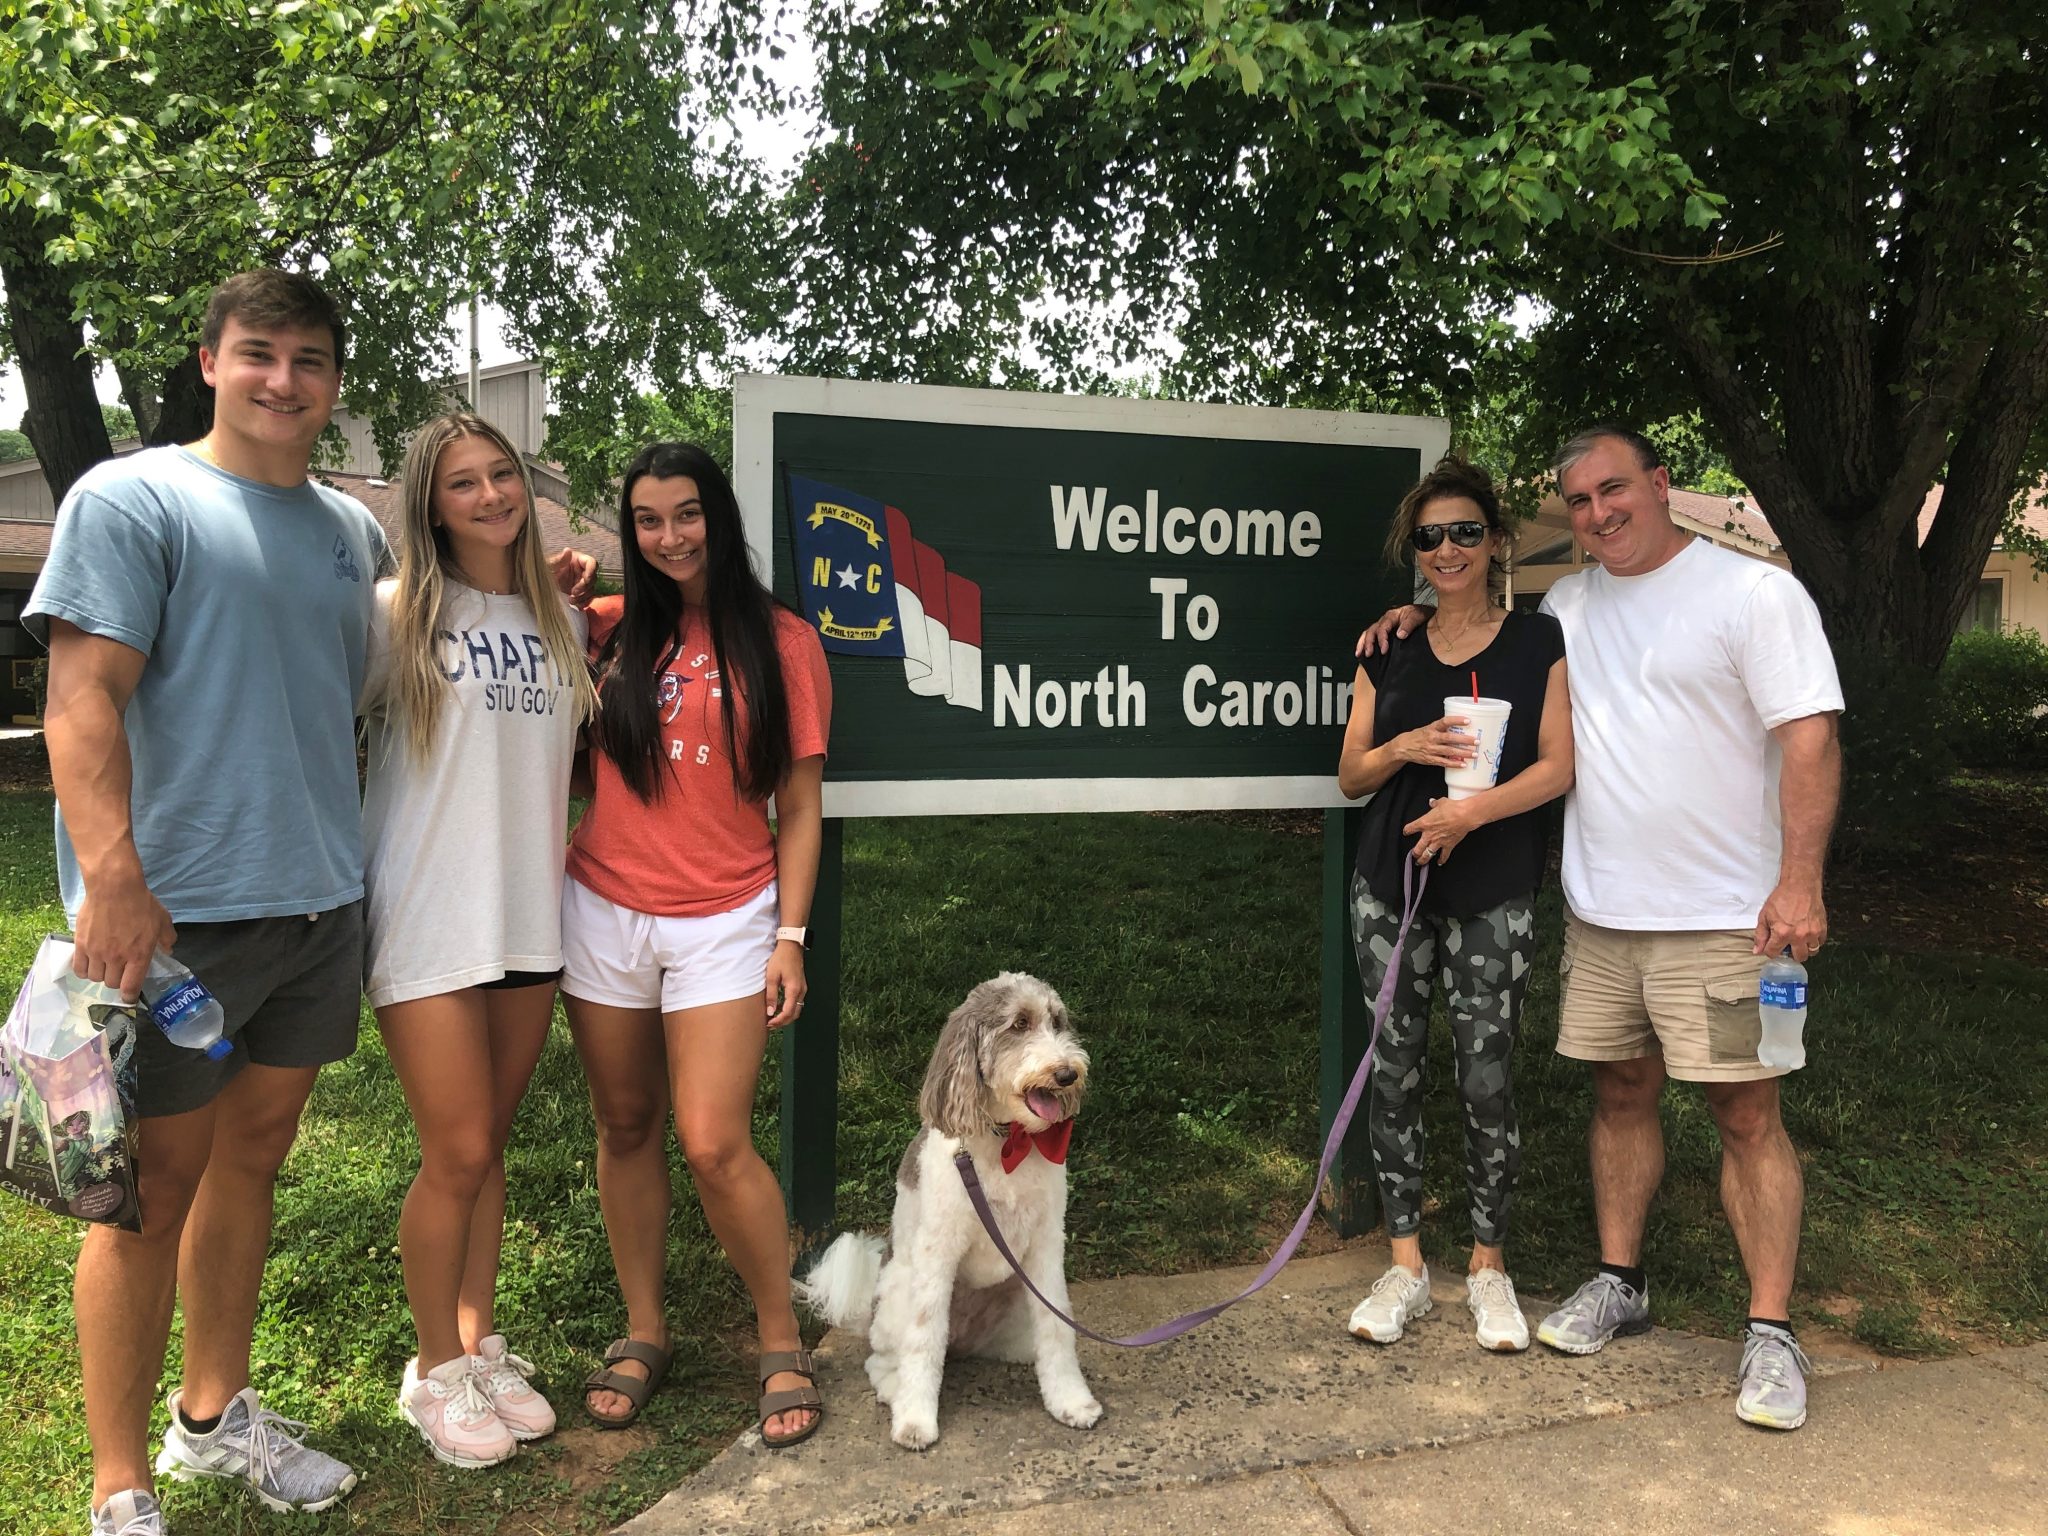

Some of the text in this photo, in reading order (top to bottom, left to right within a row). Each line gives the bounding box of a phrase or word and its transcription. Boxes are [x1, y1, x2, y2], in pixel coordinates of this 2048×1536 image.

[821, 506, 837, 516] MAY
[855, 516, 872, 530] 1775
[1050, 484, 1322, 557] Welcome
[812, 556, 882, 594] N C
[1150, 577, 1219, 641] To
[825, 625, 846, 637] APRIL
[860, 630, 877, 638] 1776
[438, 630, 573, 687] CHAP
[485, 683, 559, 716] STU GOV
[993, 664, 1147, 728] North
[158, 984, 204, 1020] AQUAFINA
[0, 1180, 52, 1209] eatty
